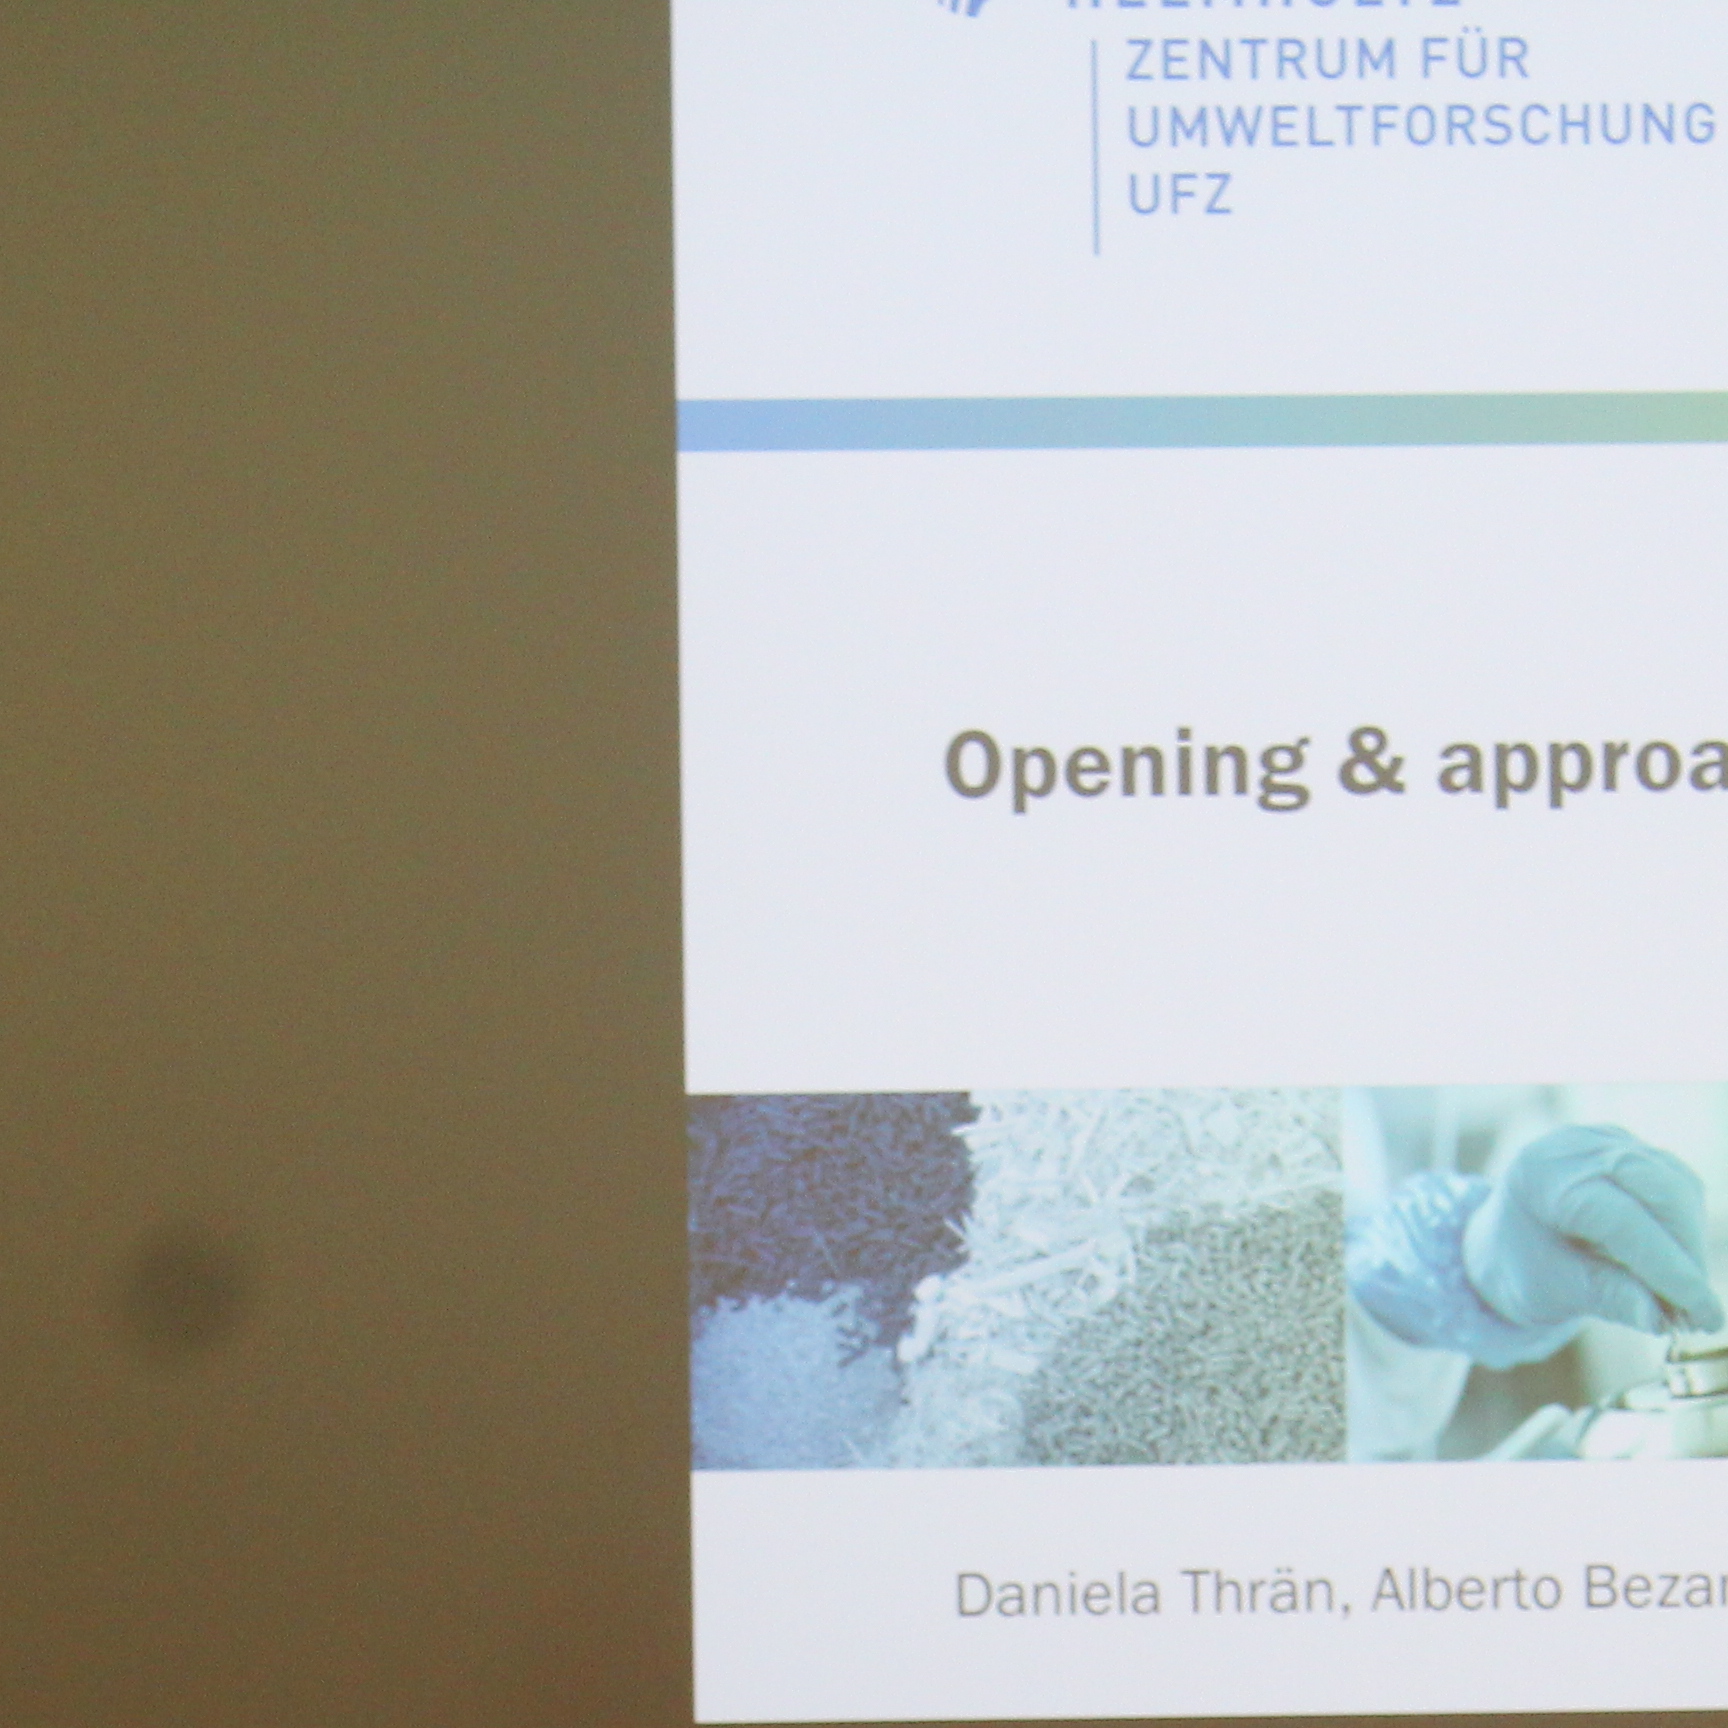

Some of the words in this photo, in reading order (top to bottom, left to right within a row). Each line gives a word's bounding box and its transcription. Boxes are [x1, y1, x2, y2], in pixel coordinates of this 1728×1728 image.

[1126, 37, 1396, 81] ZENTRUM
[1421, 26, 1529, 80] FÜR
[1128, 101, 1717, 148] UMWELTFORSCHUNG
[1128, 171, 1233, 215] UFZ
[944, 726, 1312, 814] Opening
[1338, 725, 1407, 796] &
[955, 1571, 1162, 1618] Daniela
[1180, 1567, 1353, 1619] Thrän,
[1371, 1565, 1564, 1613] Alberto
